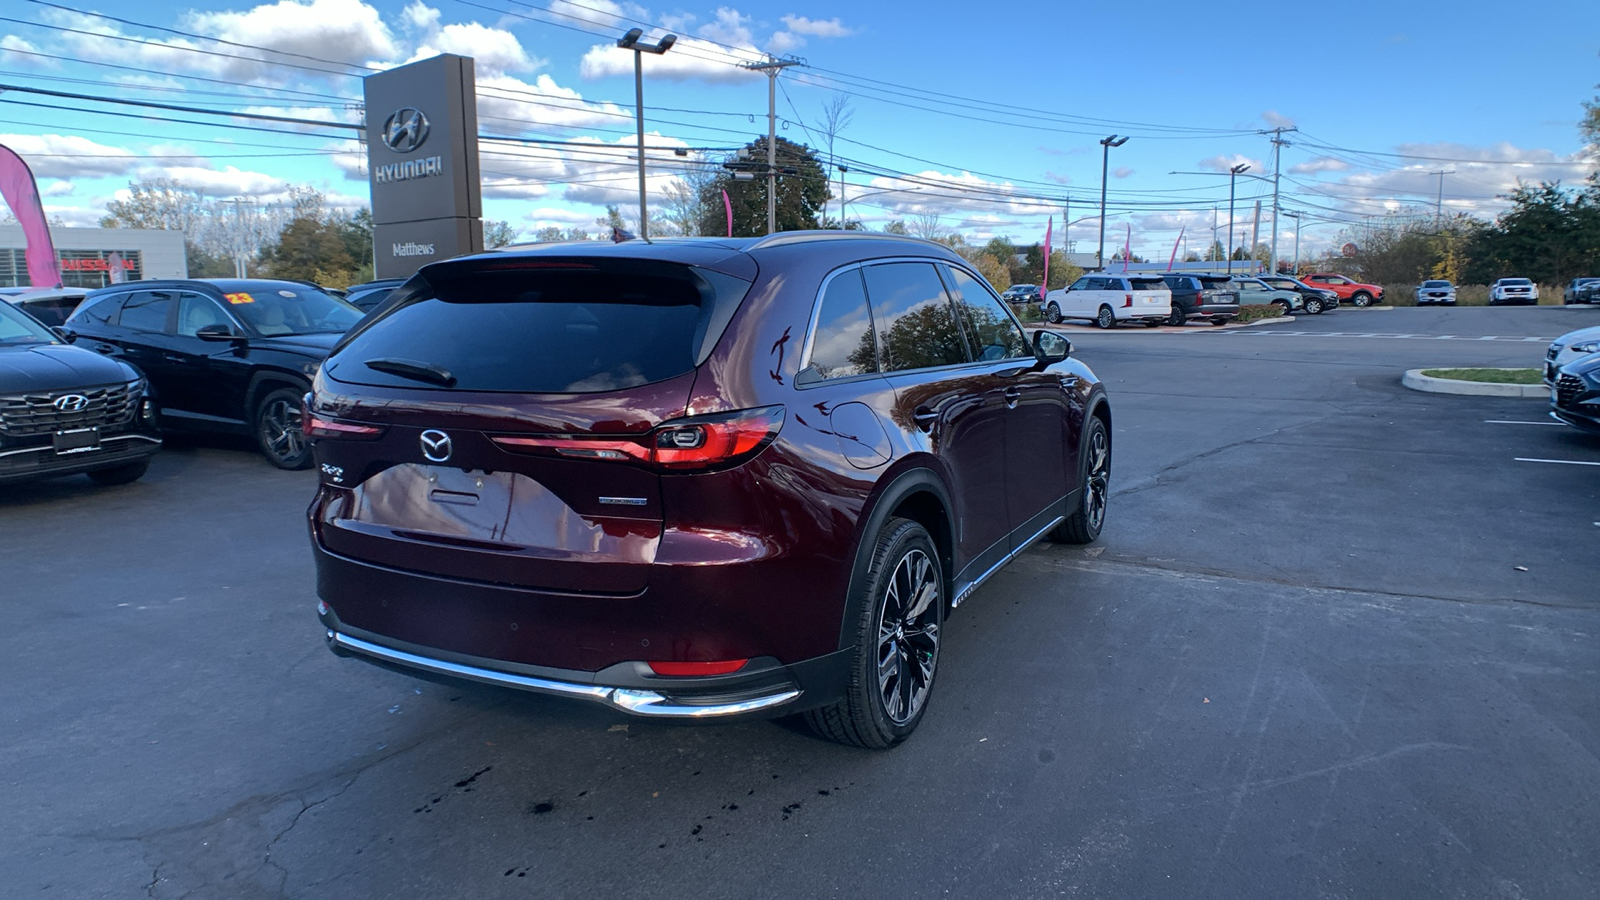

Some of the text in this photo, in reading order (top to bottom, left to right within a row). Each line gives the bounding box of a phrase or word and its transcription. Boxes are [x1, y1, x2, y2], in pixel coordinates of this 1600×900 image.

[375, 156, 442, 183] HYUNDAI
[392, 242, 435, 257] Matthews
[61, 259, 134, 270] NISSN
[225, 292, 254, 304] 23
